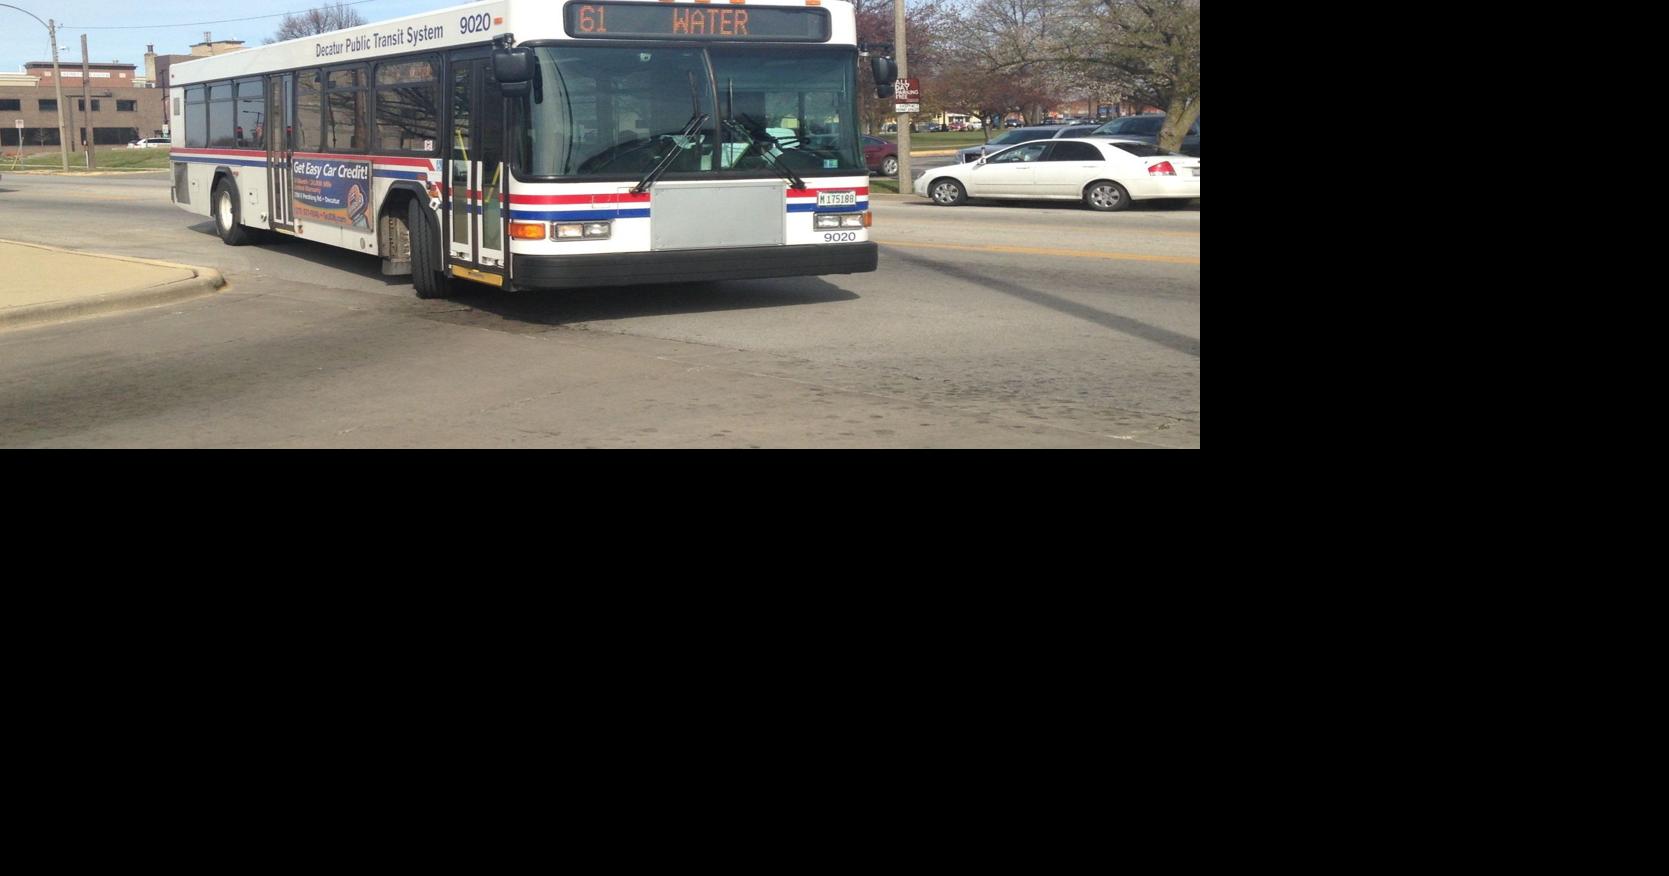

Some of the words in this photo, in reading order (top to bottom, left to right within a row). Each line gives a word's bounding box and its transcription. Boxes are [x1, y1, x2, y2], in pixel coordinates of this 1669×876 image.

[459, 12, 491, 34] 9020
[578, 5, 607, 33] 61
[672, 7, 749, 36] WATER
[315, 42, 343, 57] Decatur
[345, 35, 371, 53] Public
[373, 29, 404, 48] Transit
[407, 24, 444, 46] System
[895, 82, 910, 91] DAY
[293, 161, 305, 174] Get
[306, 162, 322, 179] Easy
[323, 164, 338, 177] Car
[338, 165, 368, 180] Credit!
[824, 232, 856, 242] 9020
